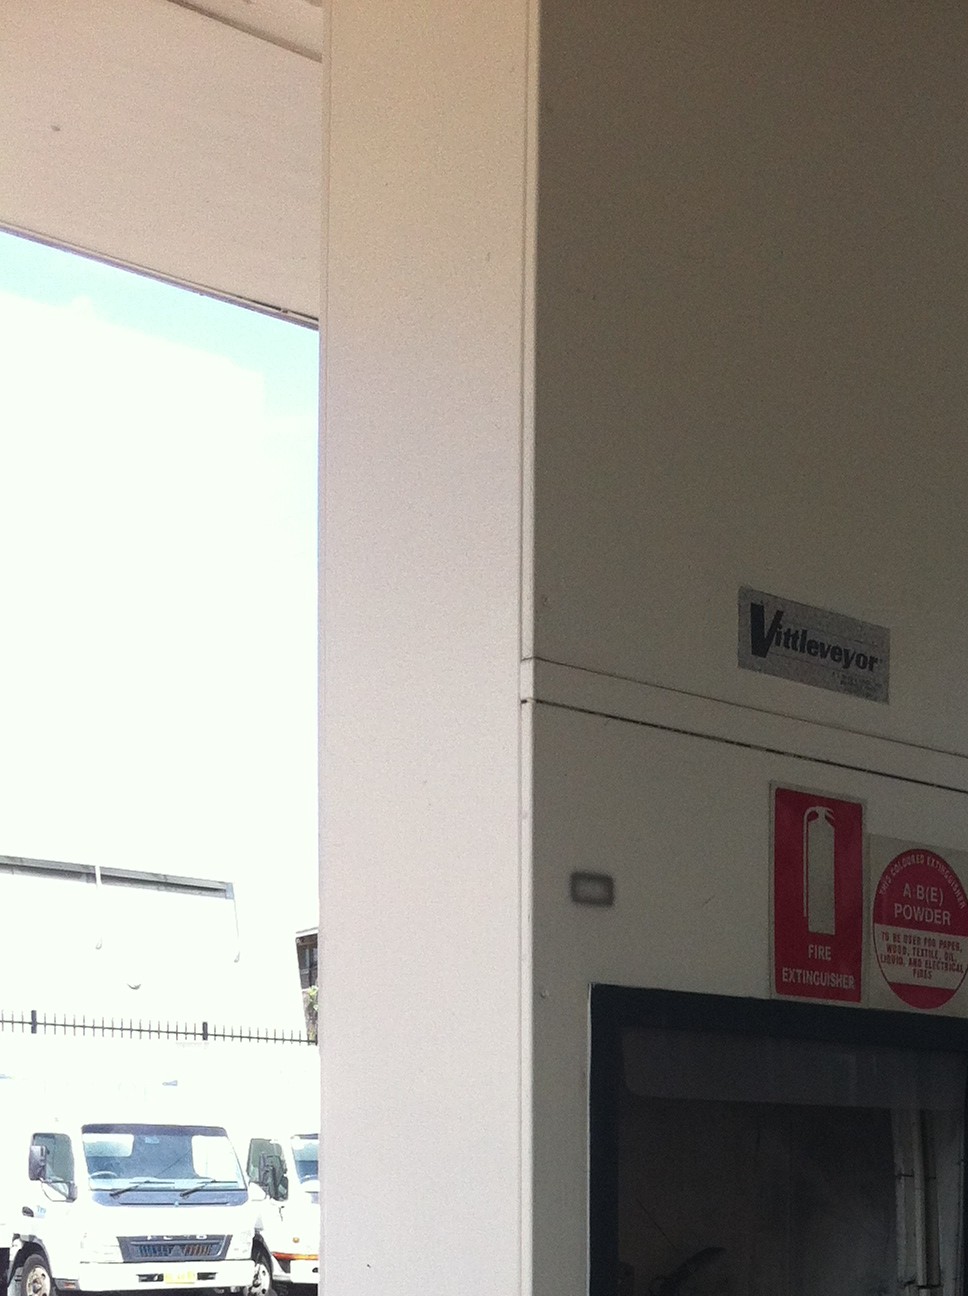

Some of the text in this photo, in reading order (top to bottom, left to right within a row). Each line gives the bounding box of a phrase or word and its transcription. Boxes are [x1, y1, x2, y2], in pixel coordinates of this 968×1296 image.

[750, 601, 879, 672] Vittleveyor
[893, 903, 951, 926] POWDER
[882, 931, 889, 942] TO
[893, 933, 901, 943] BE
[808, 944, 832, 961] FIRE
[909, 957, 922, 968] AND
[782, 968, 856, 990] EXTINGUISHER
[913, 968, 933, 980] FIRES
